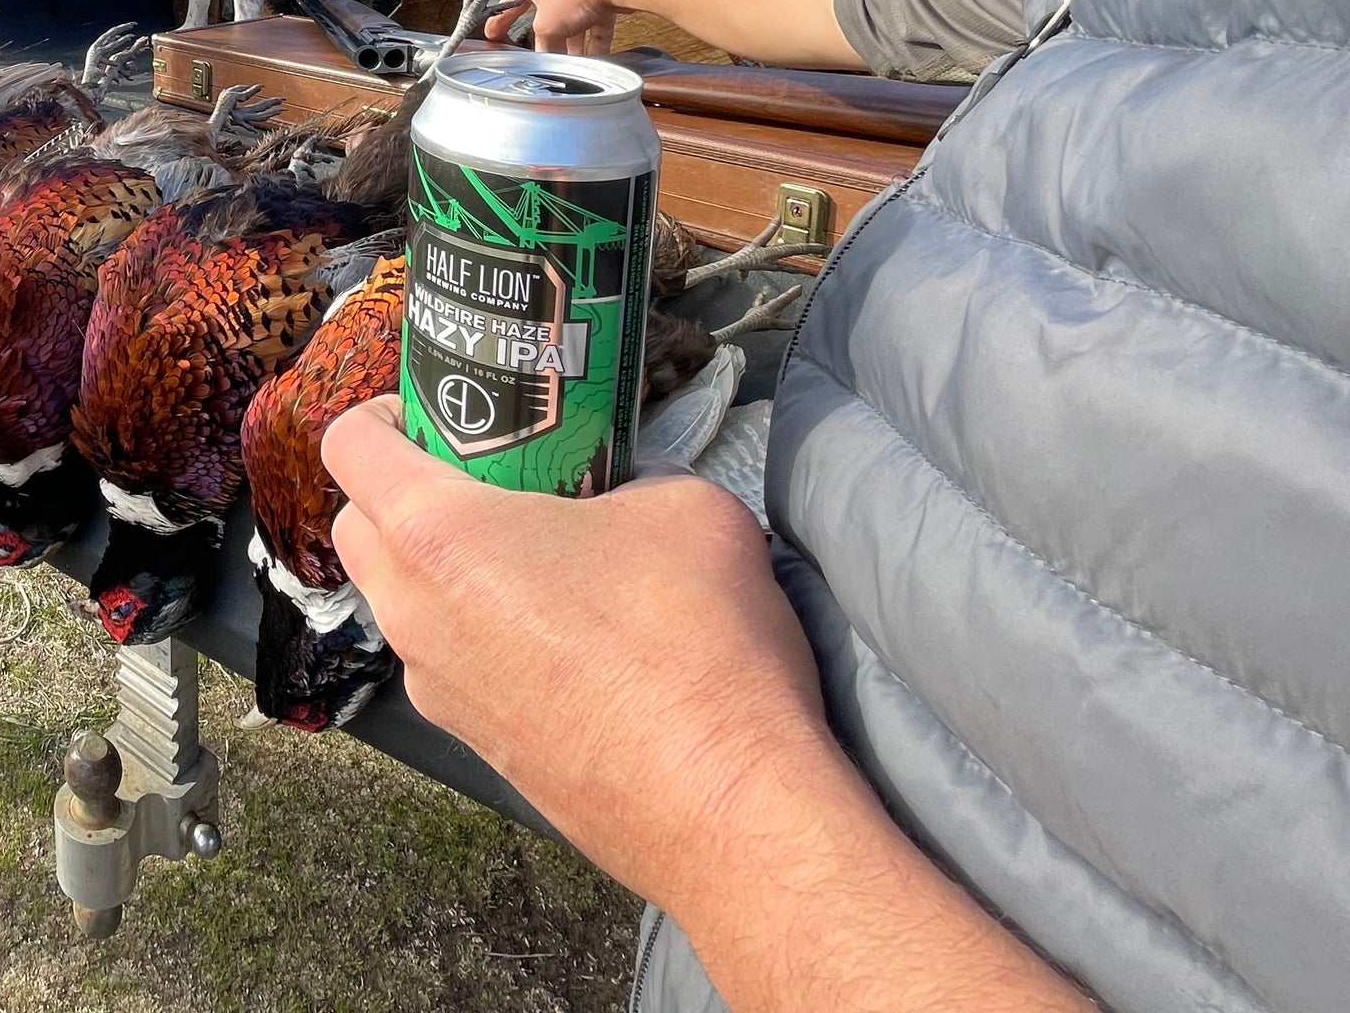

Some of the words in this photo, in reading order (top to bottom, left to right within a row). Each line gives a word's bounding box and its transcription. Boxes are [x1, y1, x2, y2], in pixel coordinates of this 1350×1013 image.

[426, 243, 473, 287] HALF
[479, 264, 530, 303] LION
[426, 272, 467, 297] BREWING
[470, 293, 529, 312] COMPANY
[408, 293, 485, 358] HAZY
[496, 337, 565, 373] IPA
[414, 282, 486, 331] WILDFIRE
[491, 319, 550, 342] HAZE
[444, 356, 463, 369] ABV
[473, 368, 484, 377] 16
[486, 371, 498, 382] FL
[500, 375, 516, 385] OZ
